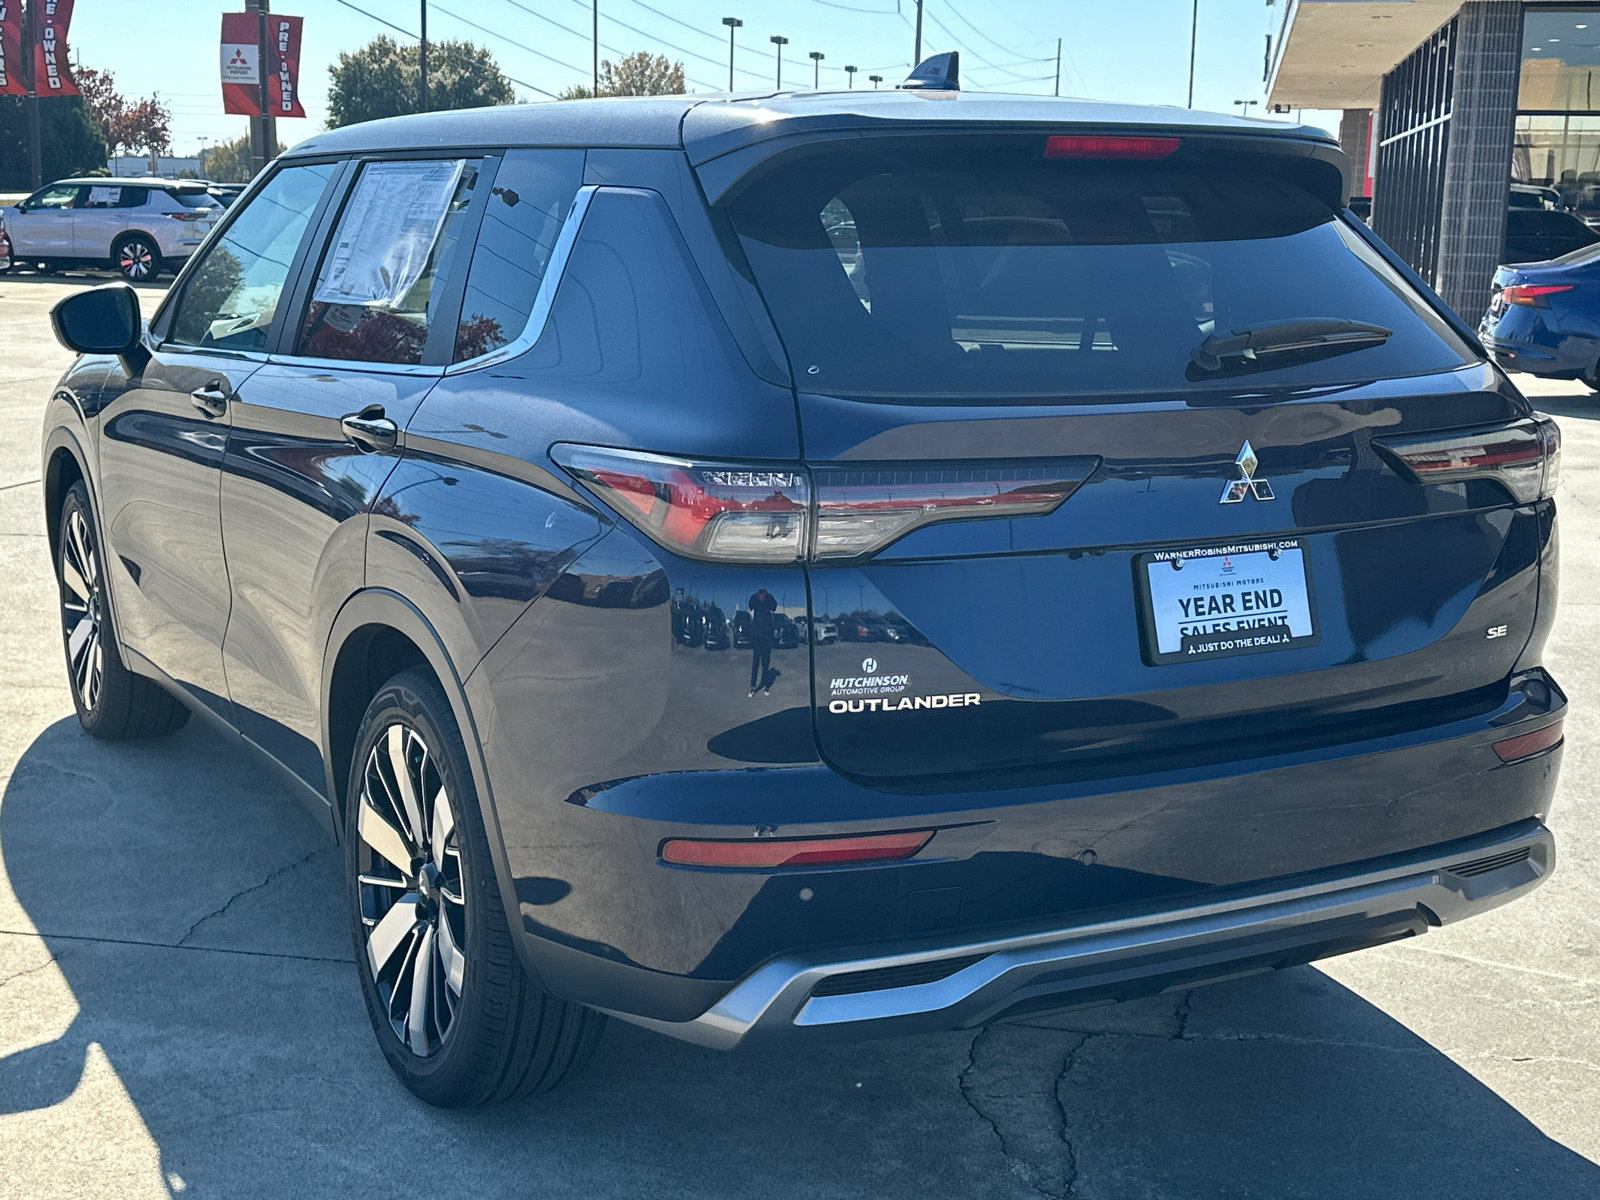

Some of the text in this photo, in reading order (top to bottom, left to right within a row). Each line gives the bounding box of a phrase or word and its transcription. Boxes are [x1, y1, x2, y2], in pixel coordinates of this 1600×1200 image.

[278, 21, 292, 111] PRE-OWNED
[1193, 577, 1265, 591] MITSUBISHI MOTORS
[1178, 588, 1283, 618] YEAR END
[1486, 624, 1508, 639] SE
[1196, 635, 1281, 653] JUST DO THE DEAL!
[829, 674, 909, 689] HUTCHINSON
[830, 685, 905, 696] AUTOMOTIVE GROUP
[828, 692, 981, 714] OUTLANDER
